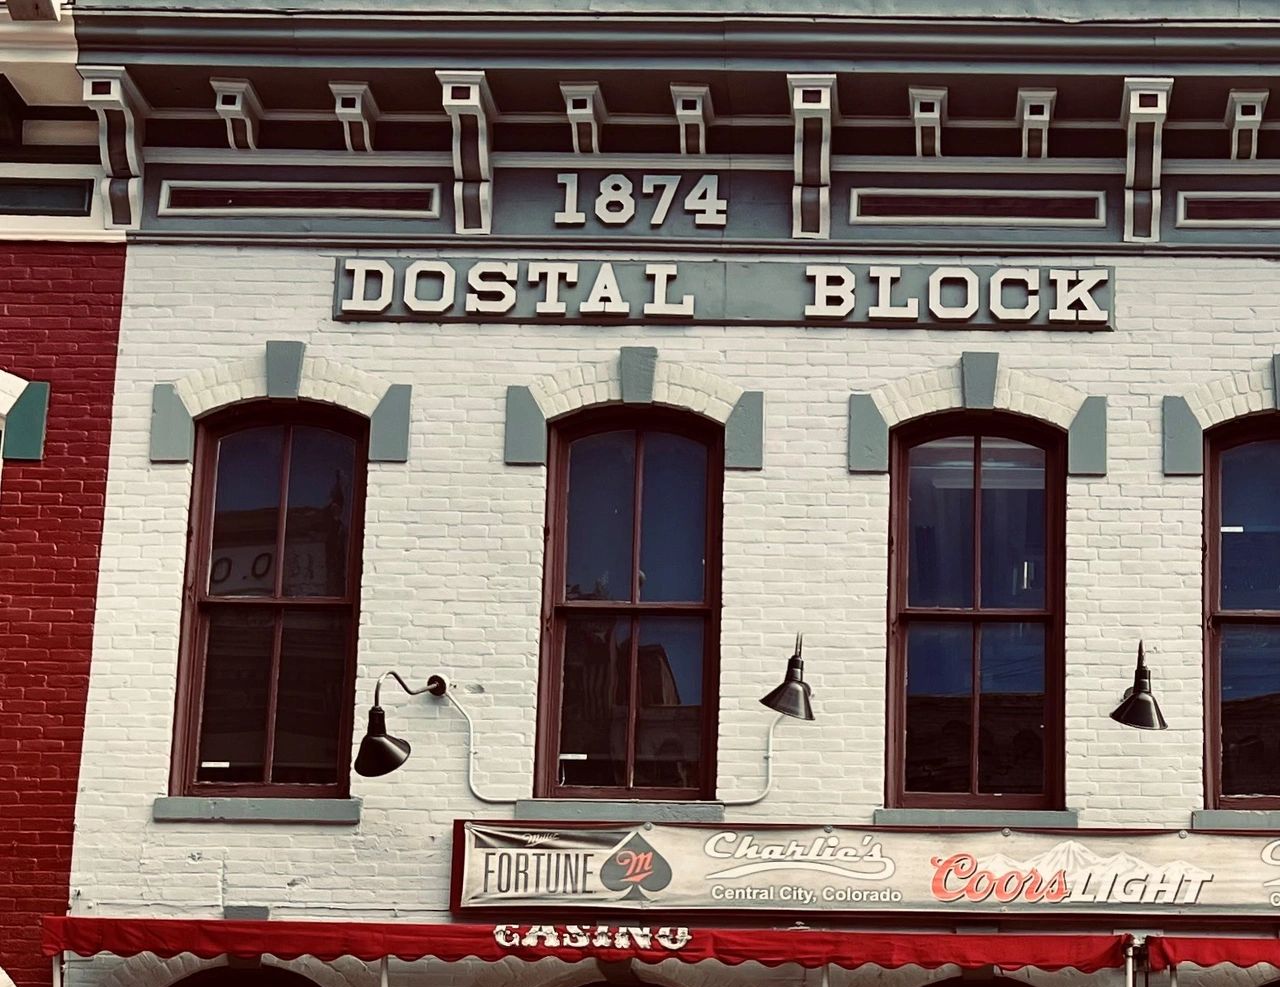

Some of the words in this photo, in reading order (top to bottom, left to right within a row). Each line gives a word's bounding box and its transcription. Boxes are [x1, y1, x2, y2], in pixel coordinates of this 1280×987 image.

[554, 172, 728, 226] 1874
[341, 257, 695, 318] DOSTAL
[805, 265, 1111, 322] BLOCK
[704, 831, 891, 867] Charlie's
[482, 852, 596, 895] FORTUNE
[711, 884, 776, 901] Central
[778, 884, 817, 904] City,
[822, 885, 903, 903] Colorado
[930, 853, 1070, 904] Coors
[1069, 872, 1215, 905] LIGHT
[493, 924, 693, 950] CASINO
